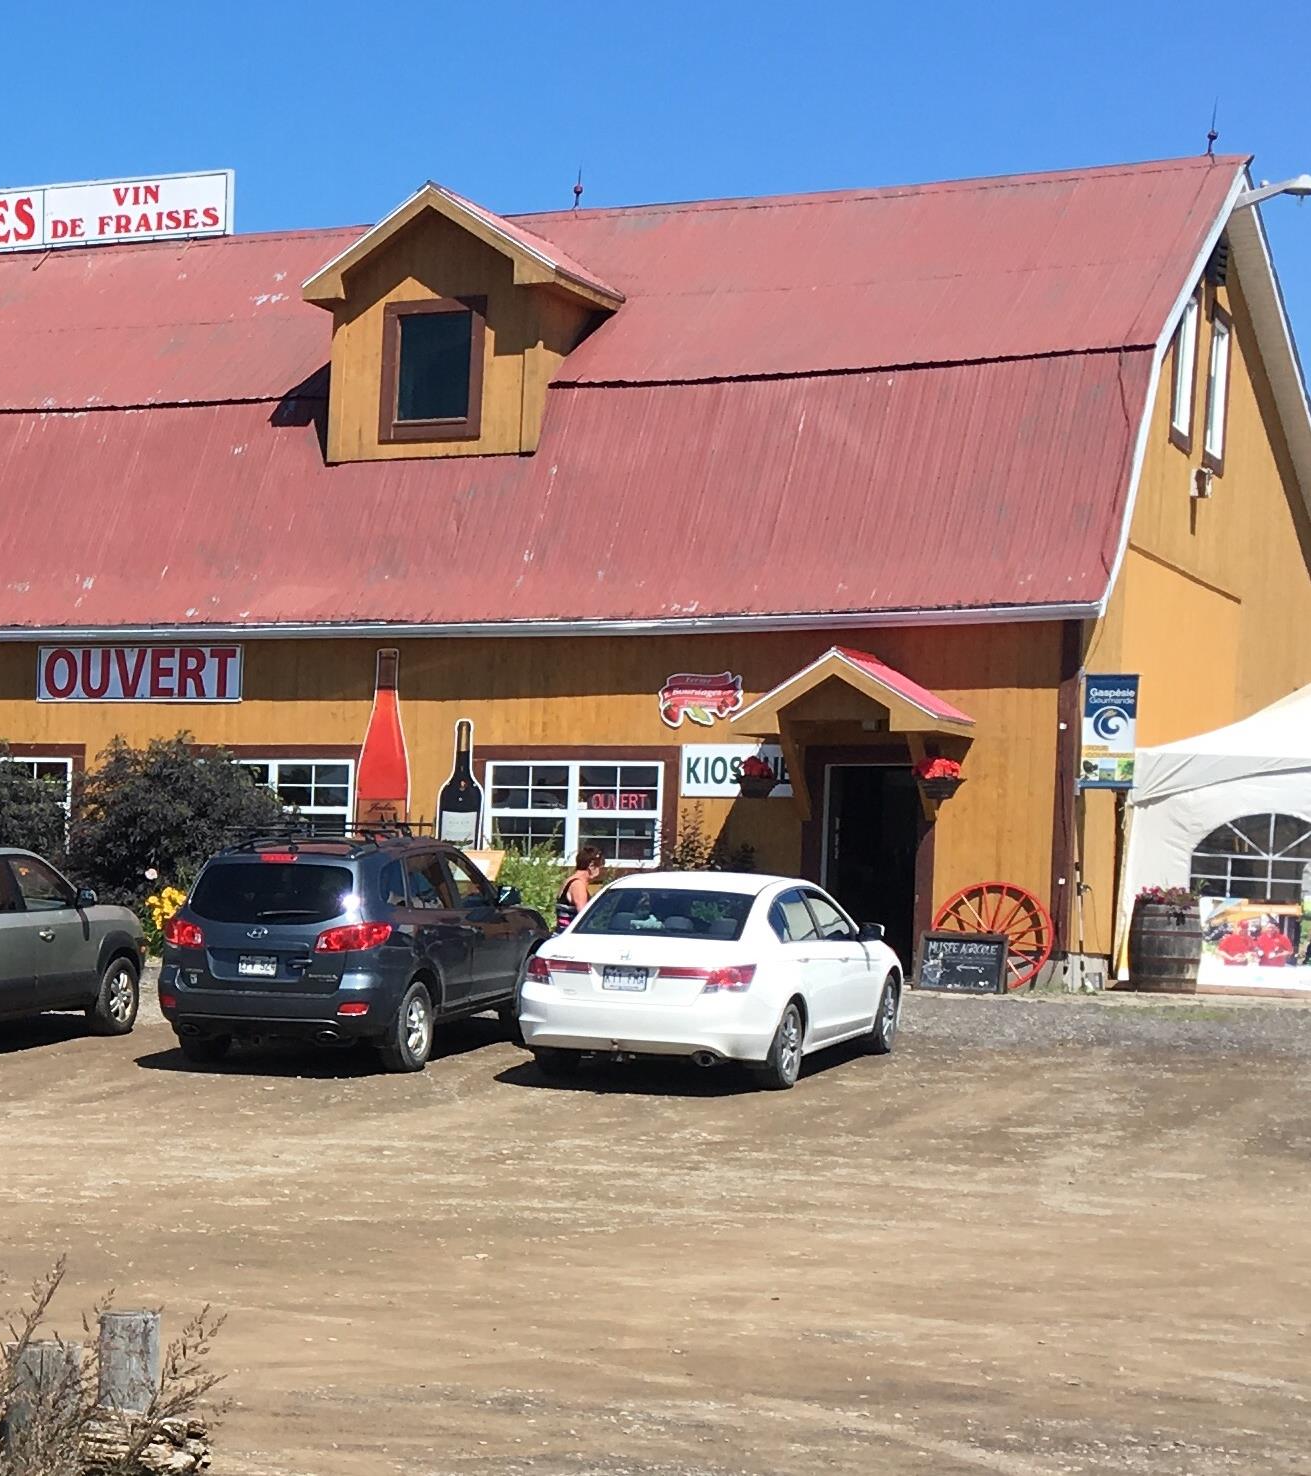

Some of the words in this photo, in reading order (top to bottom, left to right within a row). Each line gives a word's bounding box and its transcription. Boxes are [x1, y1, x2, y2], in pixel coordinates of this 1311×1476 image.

[112, 185, 160, 206] VIN
[51, 218, 85, 239] DE
[98, 207, 220, 236] FRAISES
[44, 647, 237, 699] OUVERT
[1090, 688, 1136, 698] Gaspésie
[686, 757, 790, 784] KIOSUE
[591, 793, 648, 809] OUVERT
